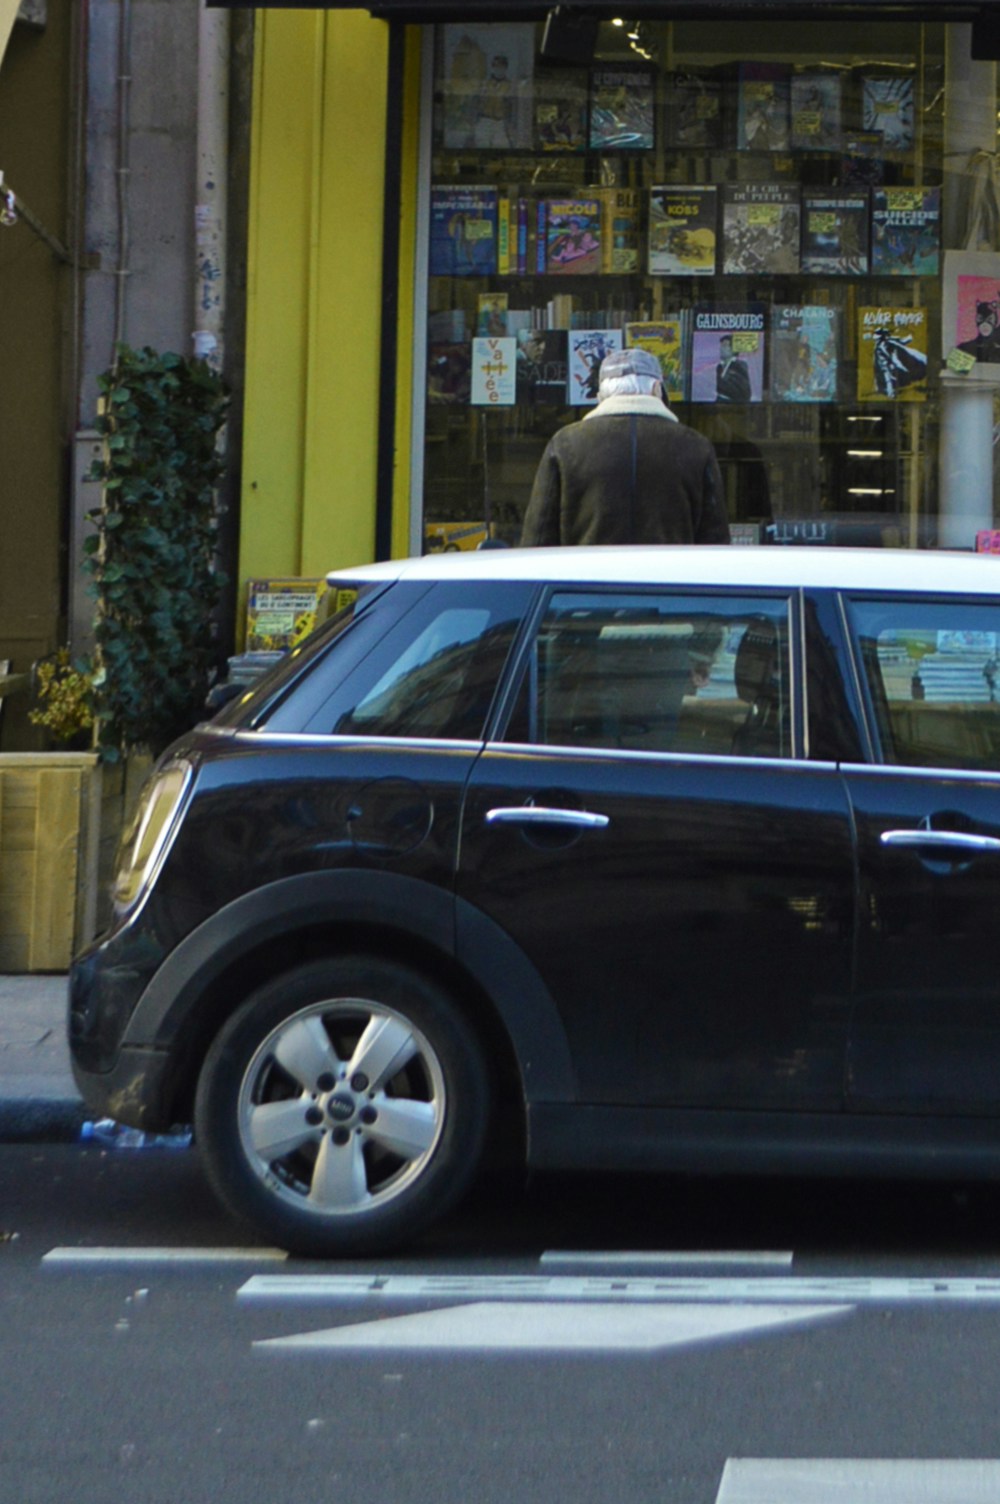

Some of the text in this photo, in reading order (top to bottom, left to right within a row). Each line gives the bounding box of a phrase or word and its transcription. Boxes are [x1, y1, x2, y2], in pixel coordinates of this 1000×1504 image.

[873, 210, 940, 220] SUICIDE
[782, 308, 835, 319] CHALAND
[695, 313, 764, 329] GAINSBOURG
[518, 361, 567, 380] SADE
